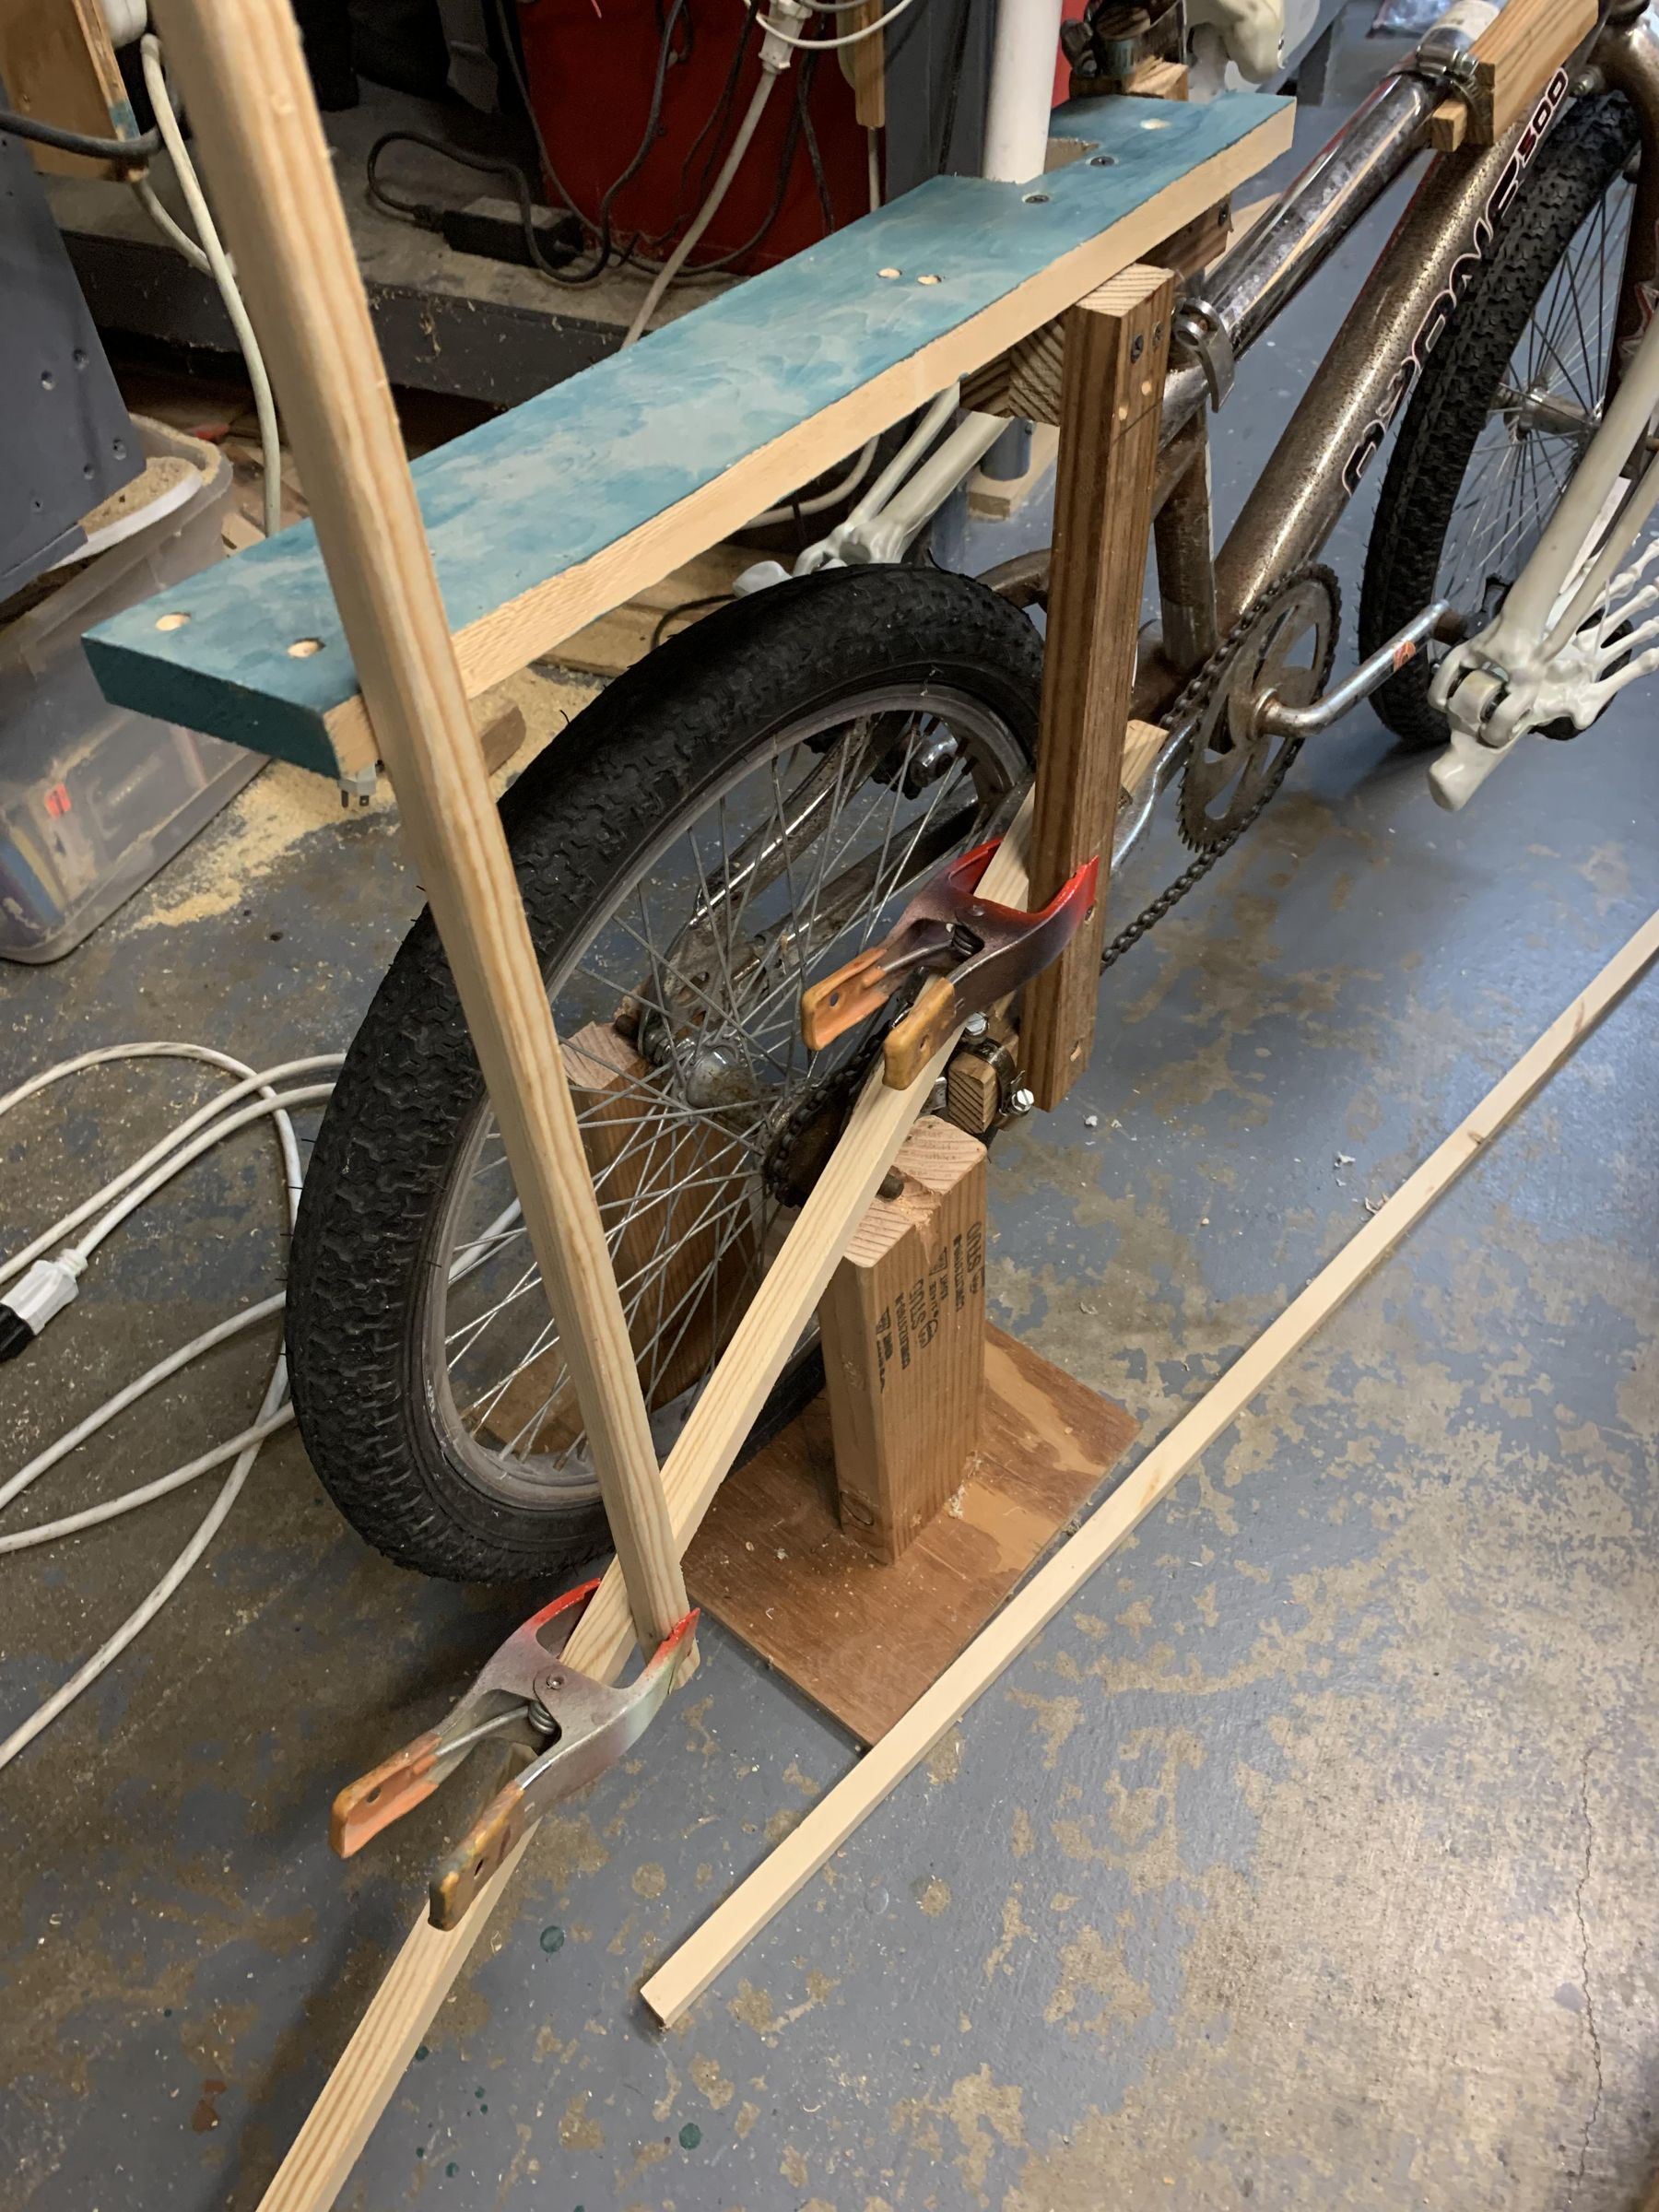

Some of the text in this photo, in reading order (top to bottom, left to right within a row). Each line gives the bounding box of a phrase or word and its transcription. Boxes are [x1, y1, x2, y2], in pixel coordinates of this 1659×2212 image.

[1516, 67, 1569, 169] 500
[966, 1221, 982, 1273] STUD
[909, 1278, 926, 1330] STUD
